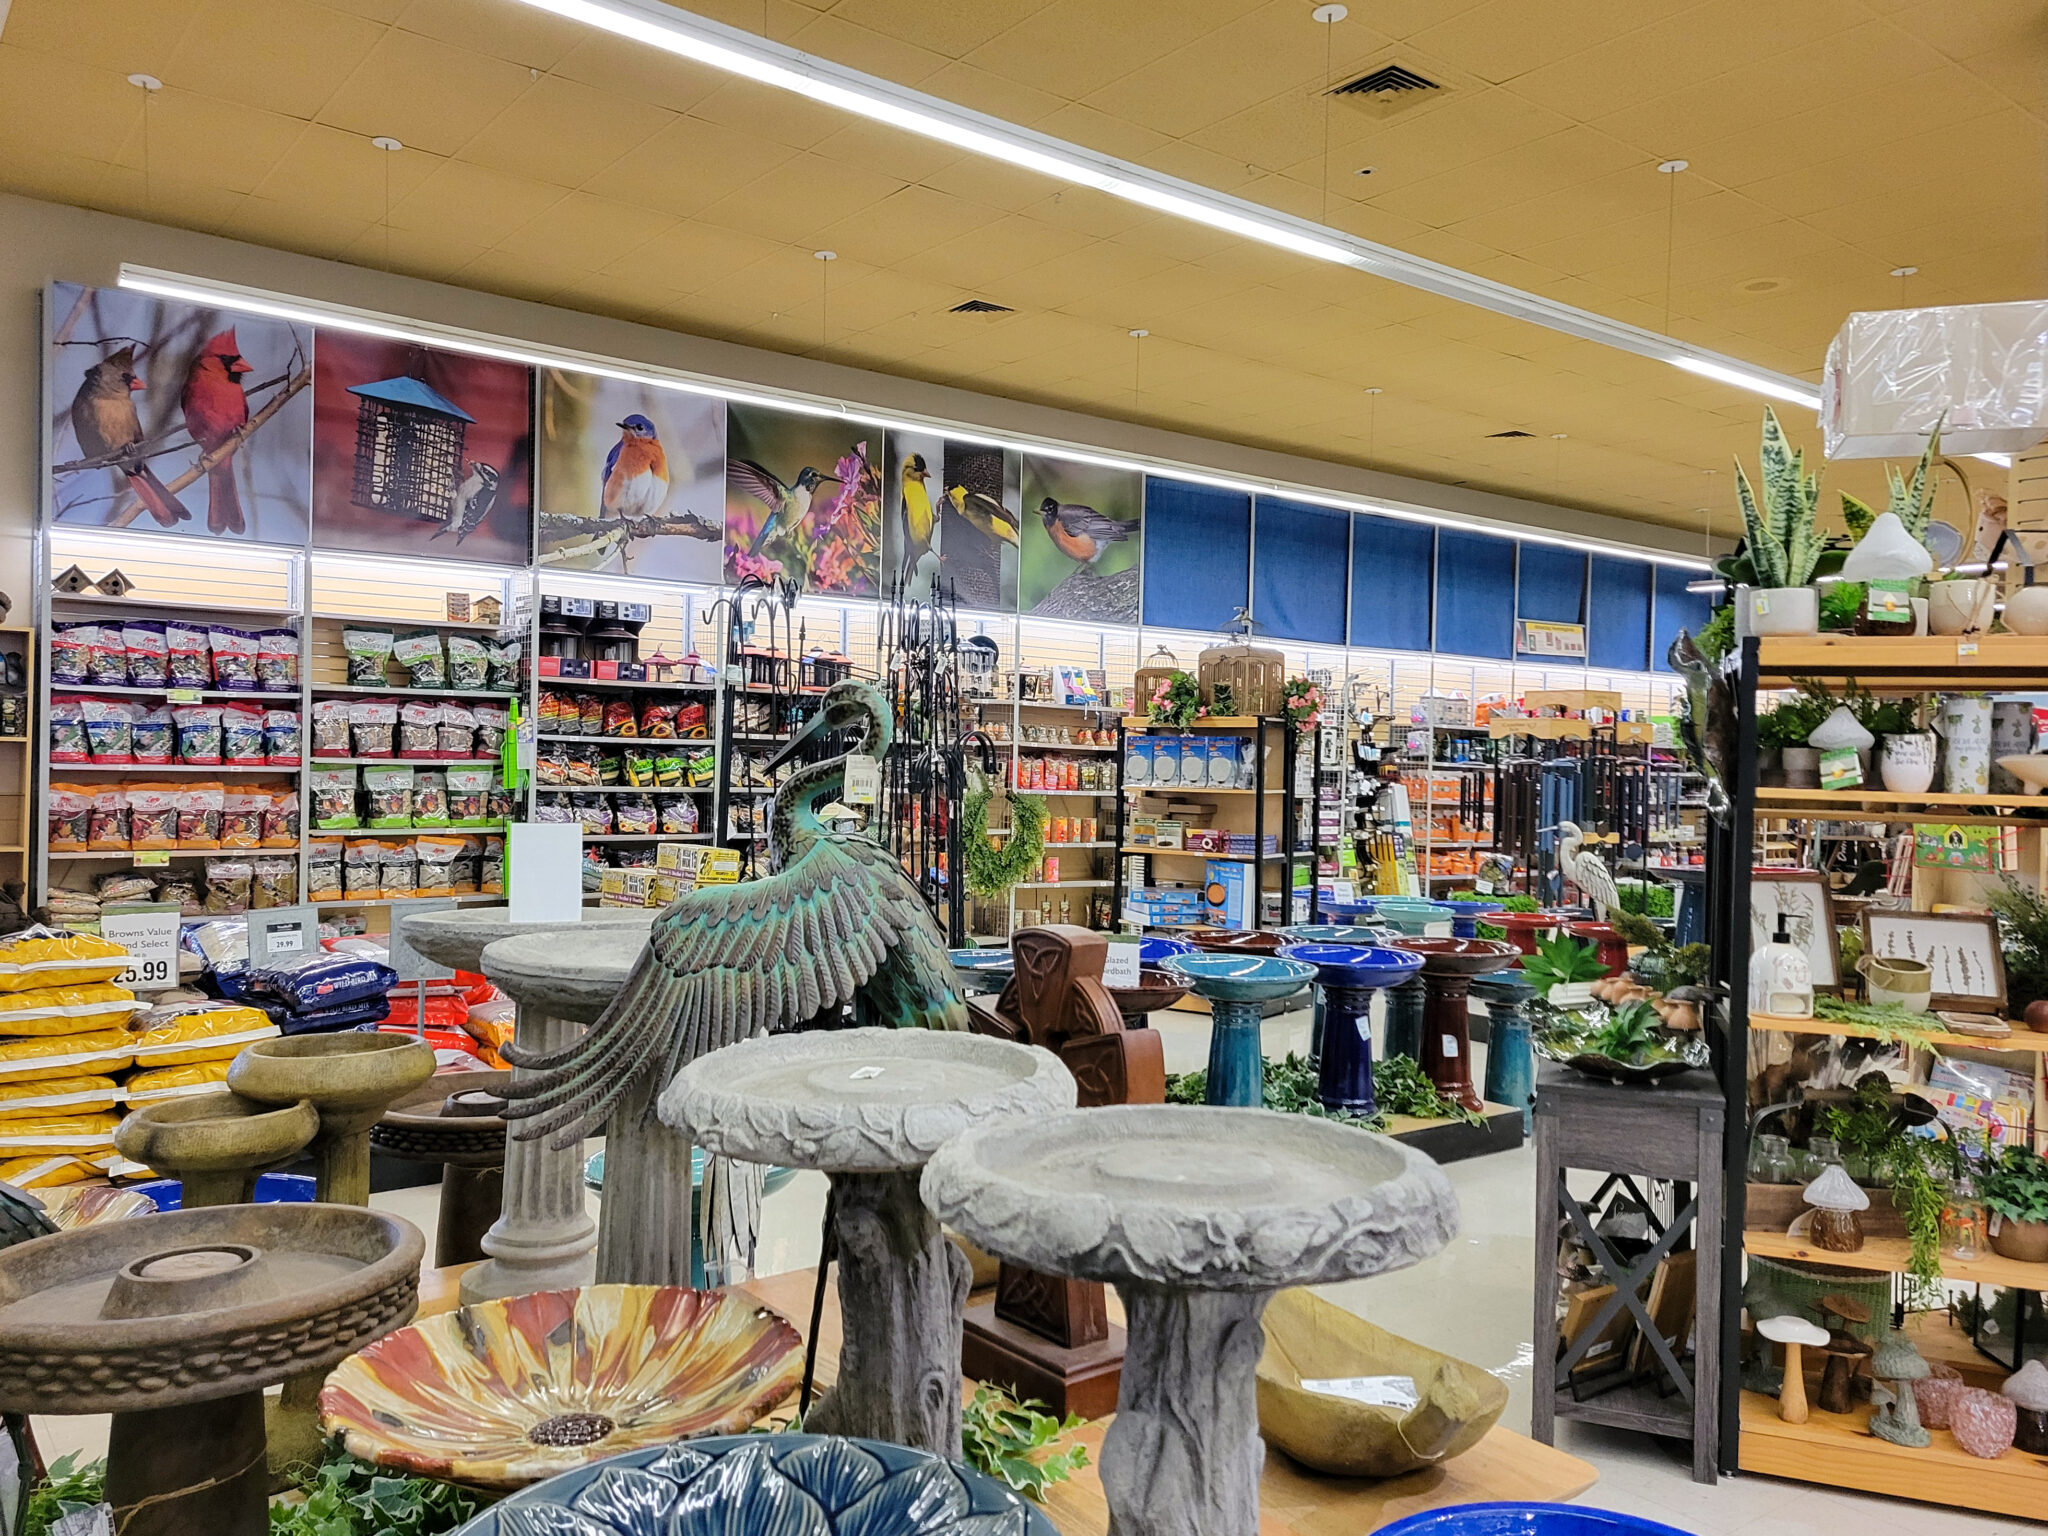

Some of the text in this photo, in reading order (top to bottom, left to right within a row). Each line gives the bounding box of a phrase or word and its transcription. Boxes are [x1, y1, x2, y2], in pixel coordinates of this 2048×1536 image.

[108, 928, 172, 939] Browns Value
[140, 940, 169, 949] Select
[333, 979, 350, 989] WILD
